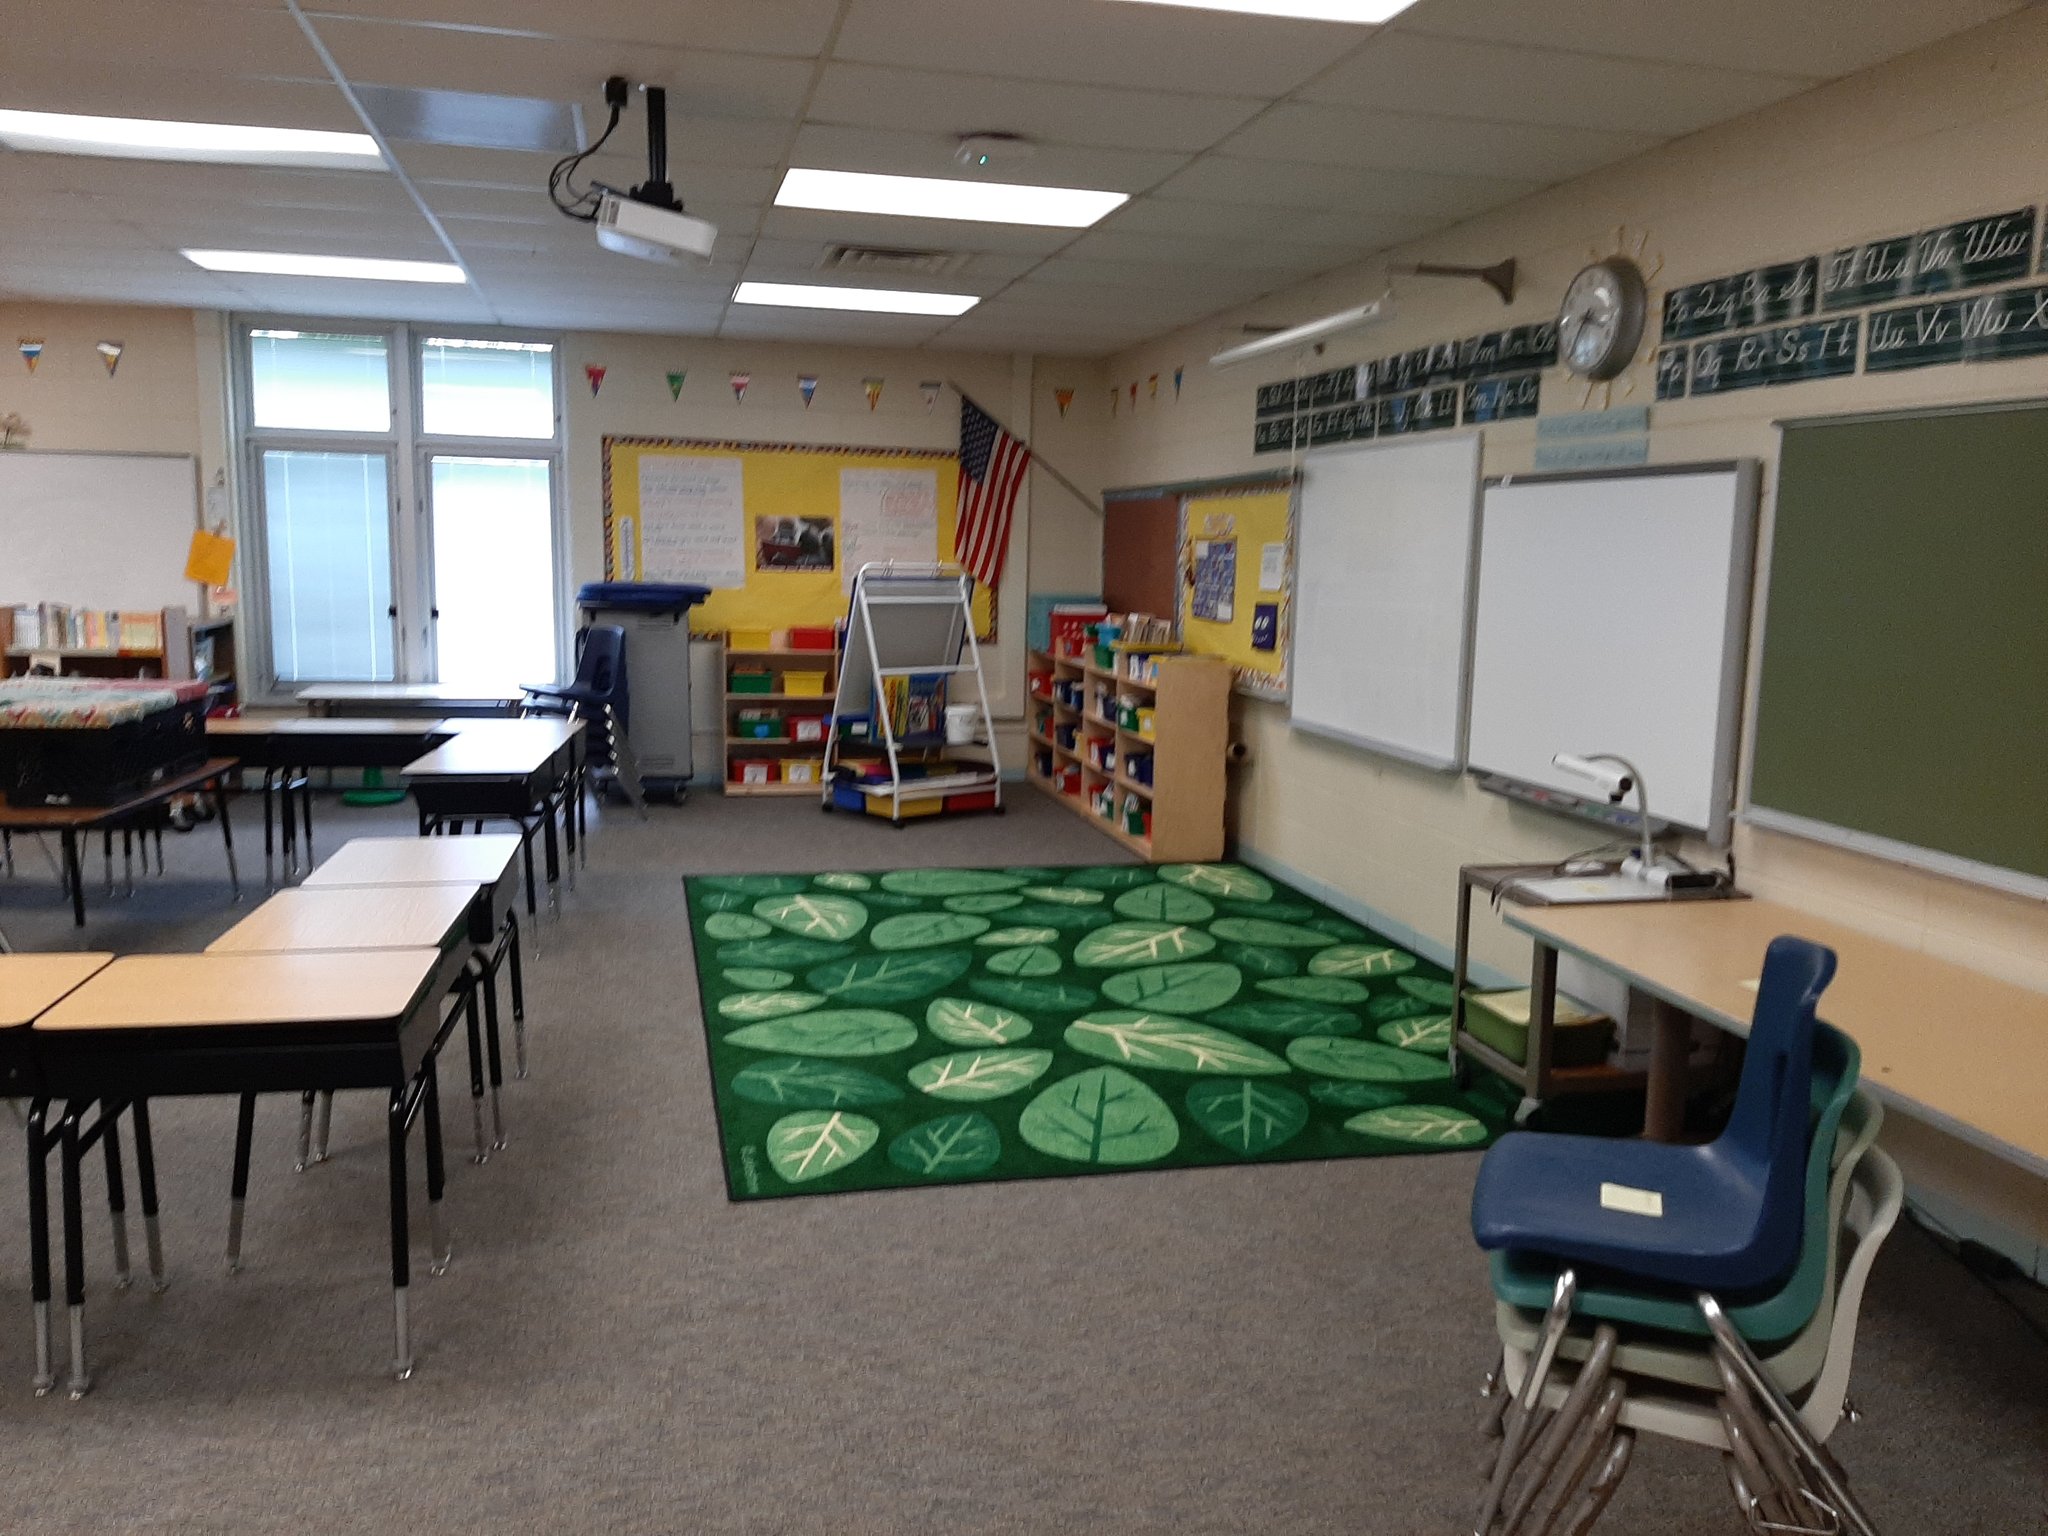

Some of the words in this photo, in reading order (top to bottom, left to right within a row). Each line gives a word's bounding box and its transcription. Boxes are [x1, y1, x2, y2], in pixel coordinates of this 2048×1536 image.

[1963, 219, 2029, 264] Ww
[1776, 328, 1810, 365] Ss
[1819, 321, 1851, 360] Tt
[1871, 312, 1908, 352] Uu
[1915, 305, 1951, 346] Vv
[1960, 297, 2014, 339] Ww
